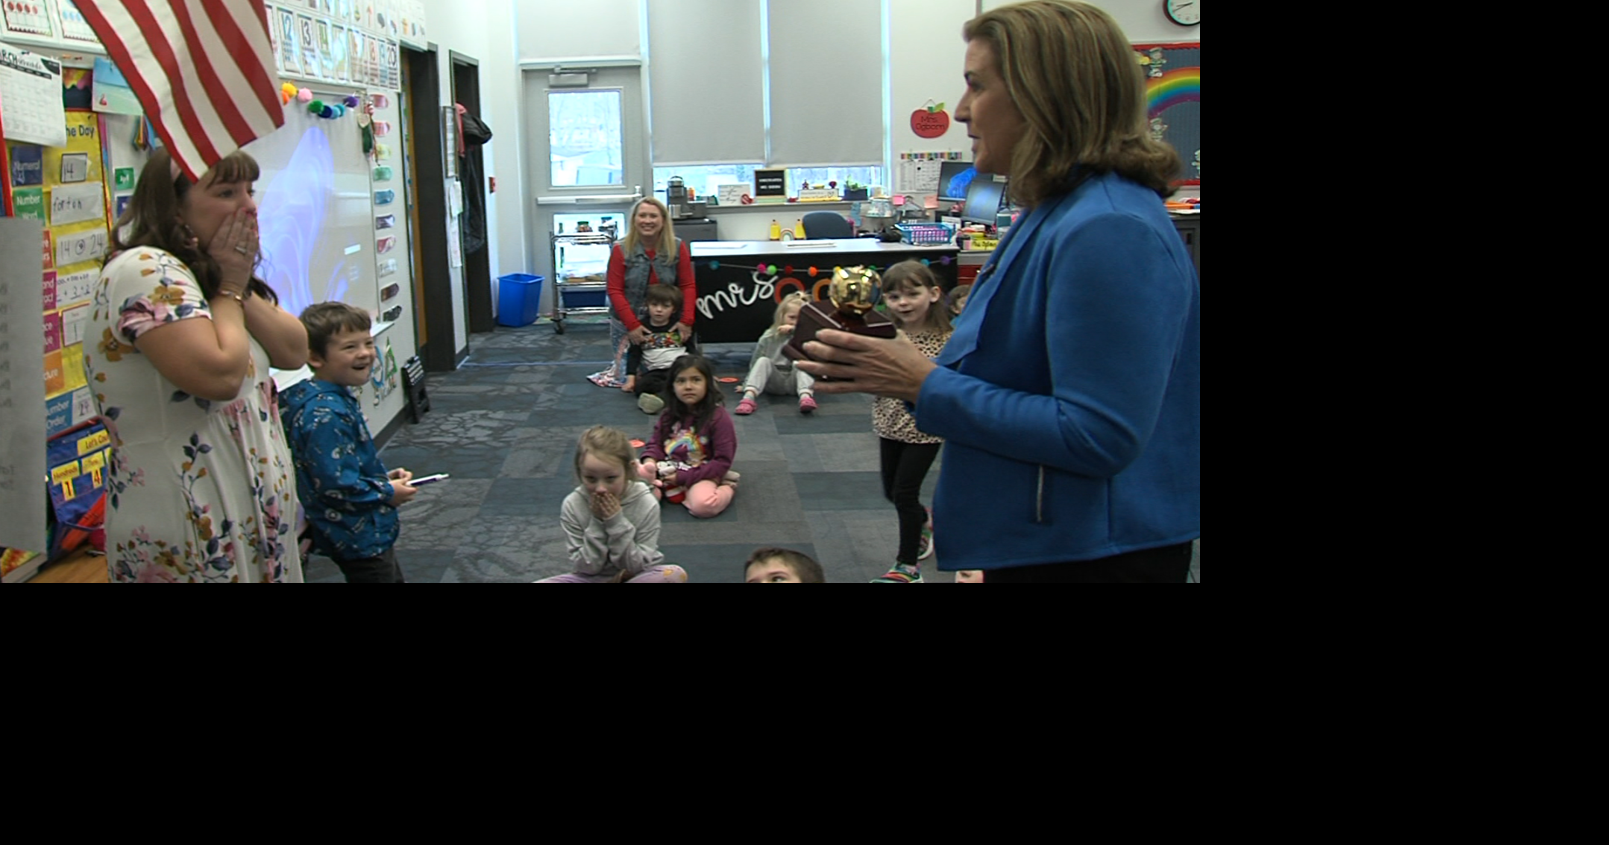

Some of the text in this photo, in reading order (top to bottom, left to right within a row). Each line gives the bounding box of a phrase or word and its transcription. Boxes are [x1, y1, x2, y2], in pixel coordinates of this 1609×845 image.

[301, 18, 312, 46] 13
[66, 125, 96, 139] he Day
[13, 159, 41, 172] Numeral
[63, 162, 75, 179] 14
[16, 194, 41, 206] Number
[696, 271, 778, 320] mrs
[65, 467, 101, 497] 1 4
